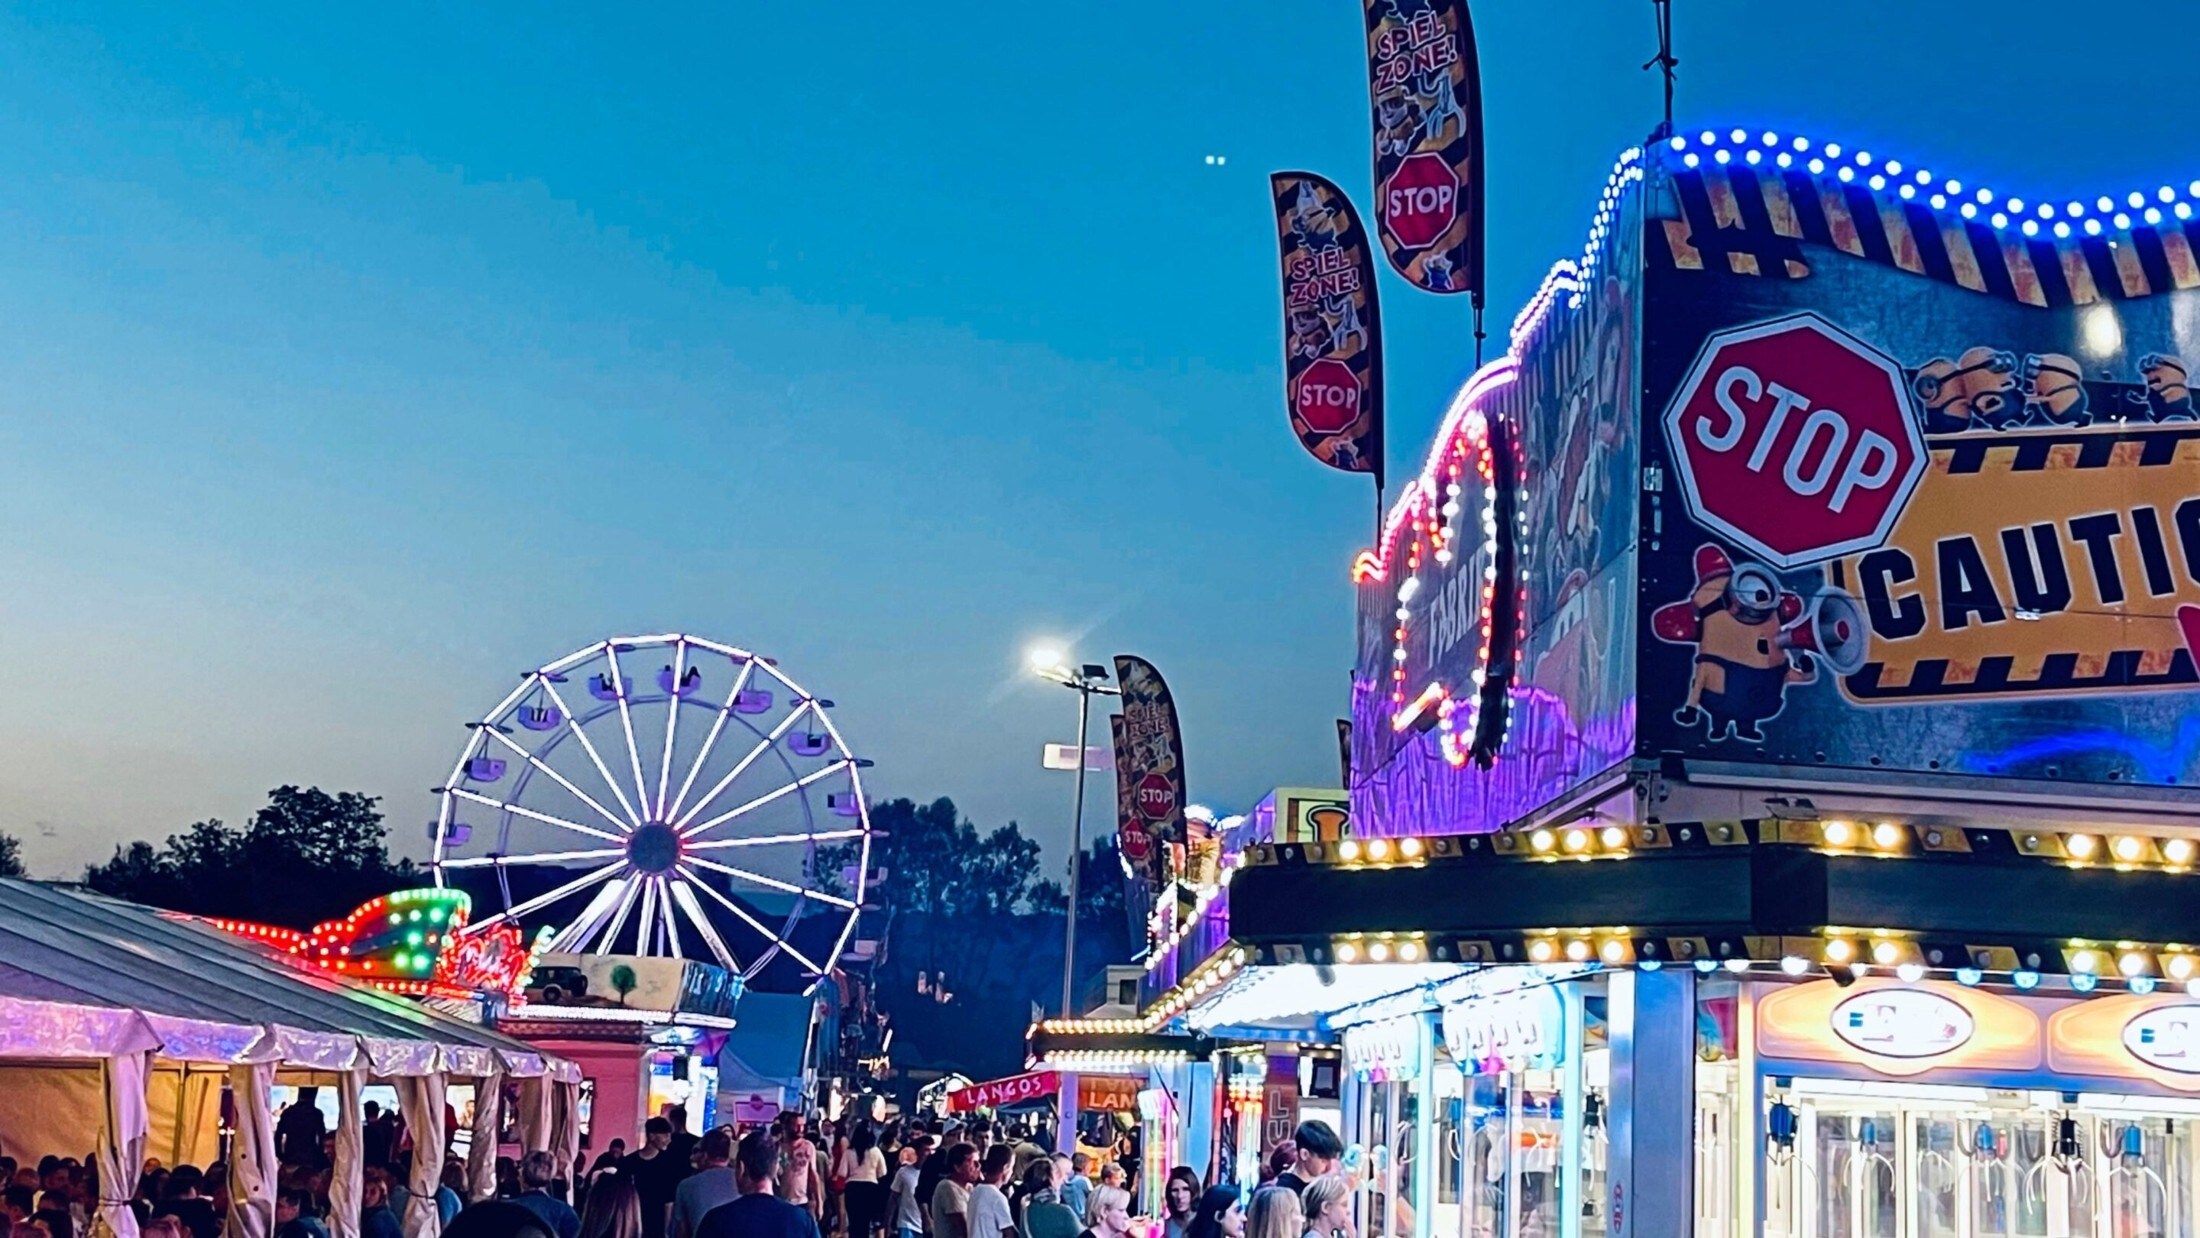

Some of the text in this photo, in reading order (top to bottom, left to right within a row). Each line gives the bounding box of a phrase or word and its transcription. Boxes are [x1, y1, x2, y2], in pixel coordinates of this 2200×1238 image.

[1378, 11, 1446, 60] SPIEL
[1376, 34, 1458, 93] ZONE!
[1390, 185, 1453, 218] STOP
[1290, 247, 1350, 281] SPIEL
[1290, 268, 1361, 306] ZONE!
[1301, 384, 1356, 409] STOP
[1696, 366, 1898, 514] STOP
[1140, 788, 1173, 804] STOP
[1125, 829, 1151, 845] STOP
[966, 1077, 1042, 1105] LANGOS
